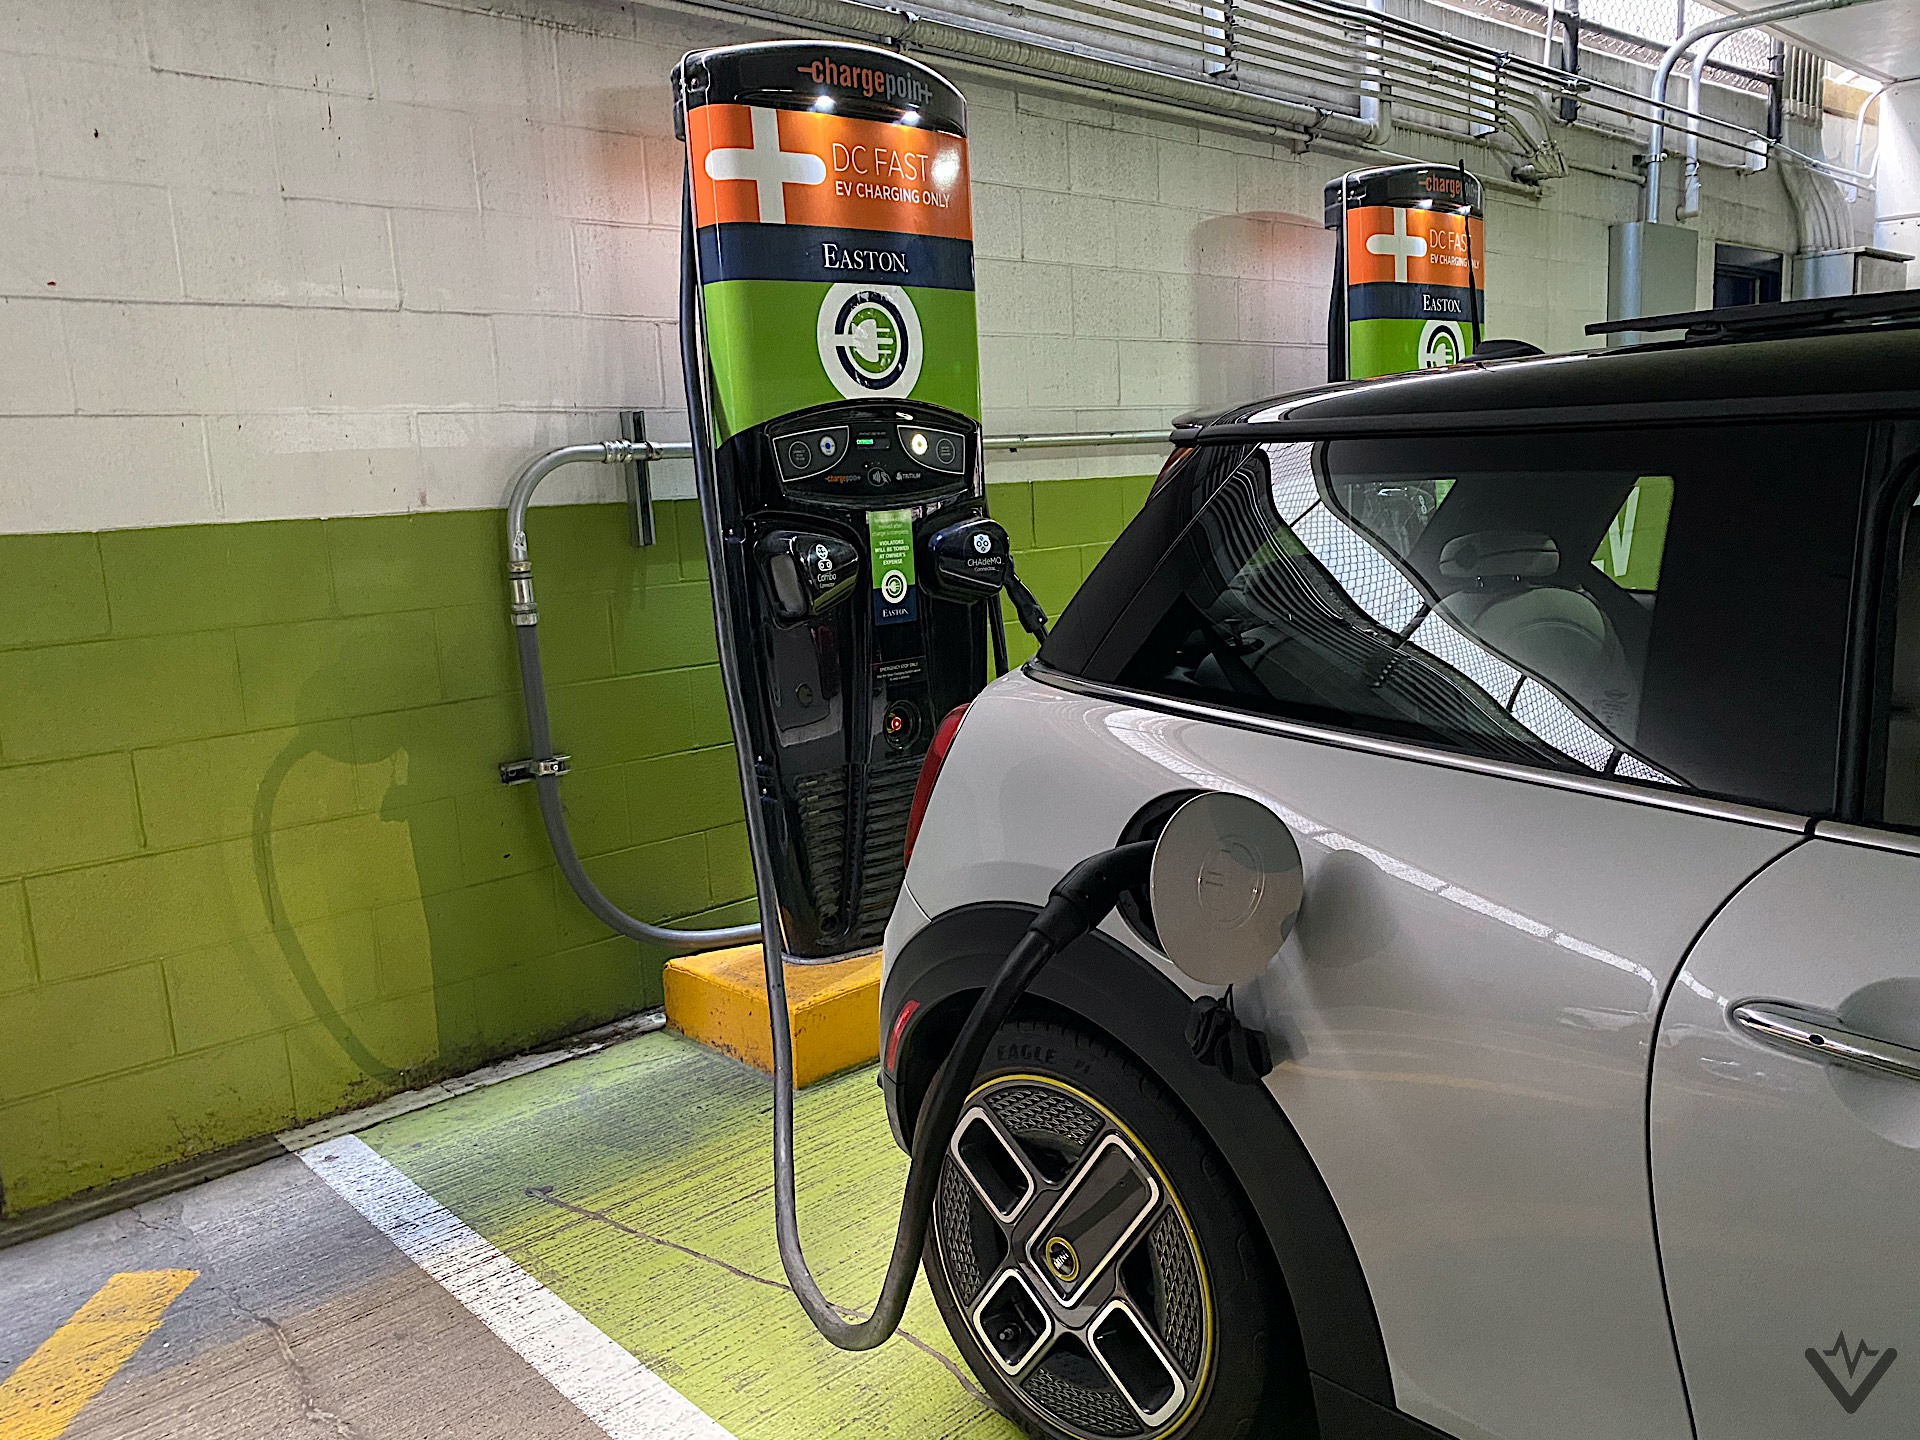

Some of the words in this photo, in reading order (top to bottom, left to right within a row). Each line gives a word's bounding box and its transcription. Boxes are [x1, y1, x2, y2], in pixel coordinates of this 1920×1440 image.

[797, 56, 933, 104] chargepoint
[832, 142, 868, 174] DC
[874, 147, 929, 182] FAST
[835, 180, 852, 197] EV
[856, 182, 920, 204] CHARGING
[922, 190, 950, 209] ONLY
[1429, 228, 1446, 250] DC
[1448, 231, 1472, 253] FAS
[1430, 253, 1439, 264] EV
[1439, 254, 1468, 268] CHARGING
[1468, 258, 1480, 269] NLY
[817, 573, 837, 582] Combo
[997, 1043, 1059, 1064] EAGLE
